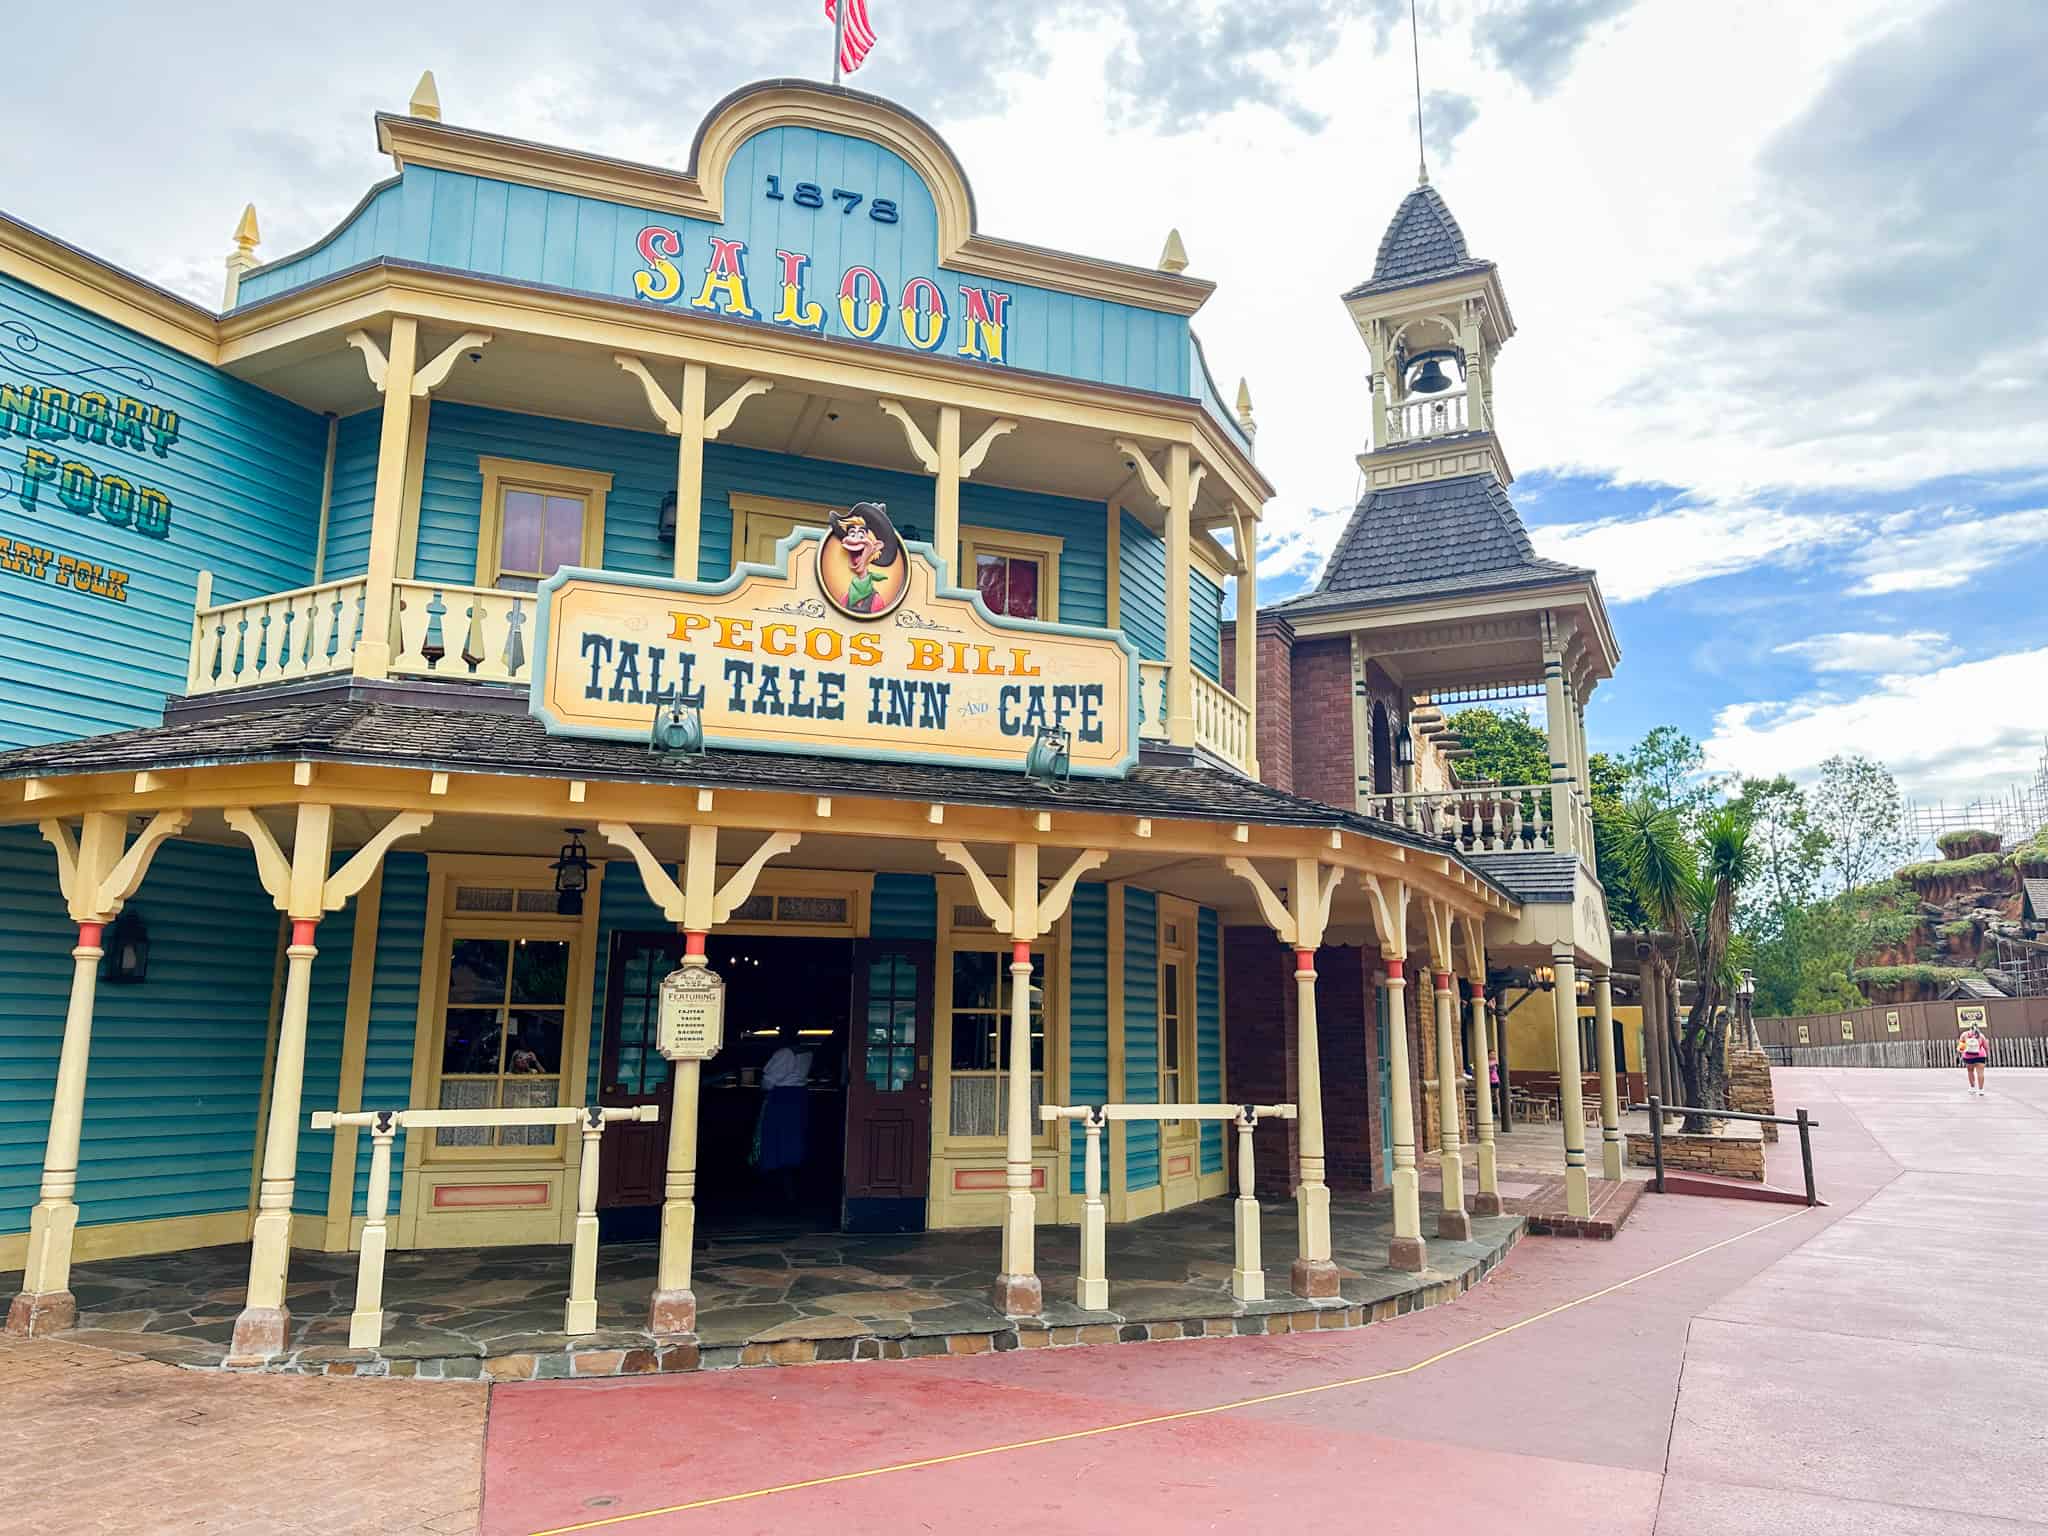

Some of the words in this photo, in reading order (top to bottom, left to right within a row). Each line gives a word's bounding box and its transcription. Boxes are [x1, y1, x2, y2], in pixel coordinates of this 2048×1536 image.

[765, 174, 899, 225] 1878
[632, 225, 1013, 365] SALOON
[19, 446, 173, 539] FOOD
[55, 553, 130, 602] FOLK
[666, 610, 883, 667] PECOS
[906, 636, 1042, 678] BILL
[581, 631, 706, 712] TALL
[723, 658, 846, 722] TALE
[867, 676, 951, 731] INN
[997, 682, 1105, 743] CAFE
